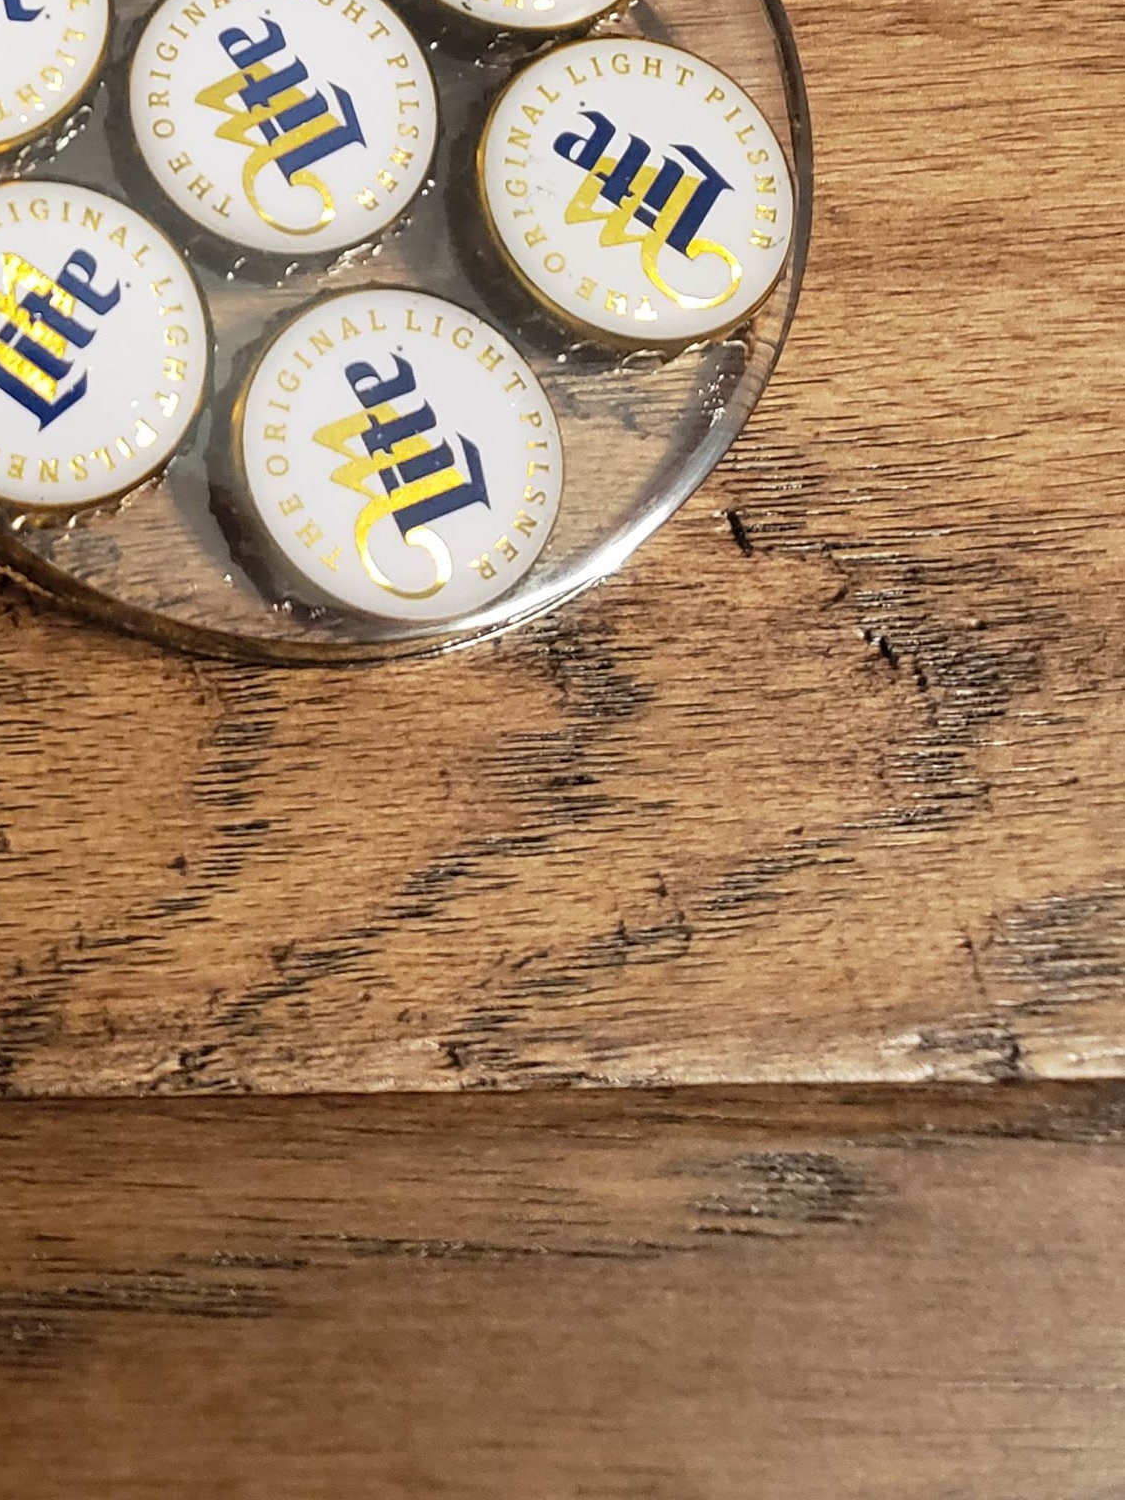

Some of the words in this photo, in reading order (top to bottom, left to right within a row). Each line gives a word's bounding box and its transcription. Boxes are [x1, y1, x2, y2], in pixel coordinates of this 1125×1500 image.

[168, 152, 231, 220] THE
[354, 52, 421, 216] PILSNER
[503, 84, 567, 275] ORIGINAL
[564, 51, 696, 88] LIGHT
[703, 85, 779, 253] PILSNER
[262, 308, 387, 478] ORIGINAL
[405, 308, 528, 394] LIGHT
[278, 493, 341, 572] THE
[471, 409, 551, 586] PILSNER
